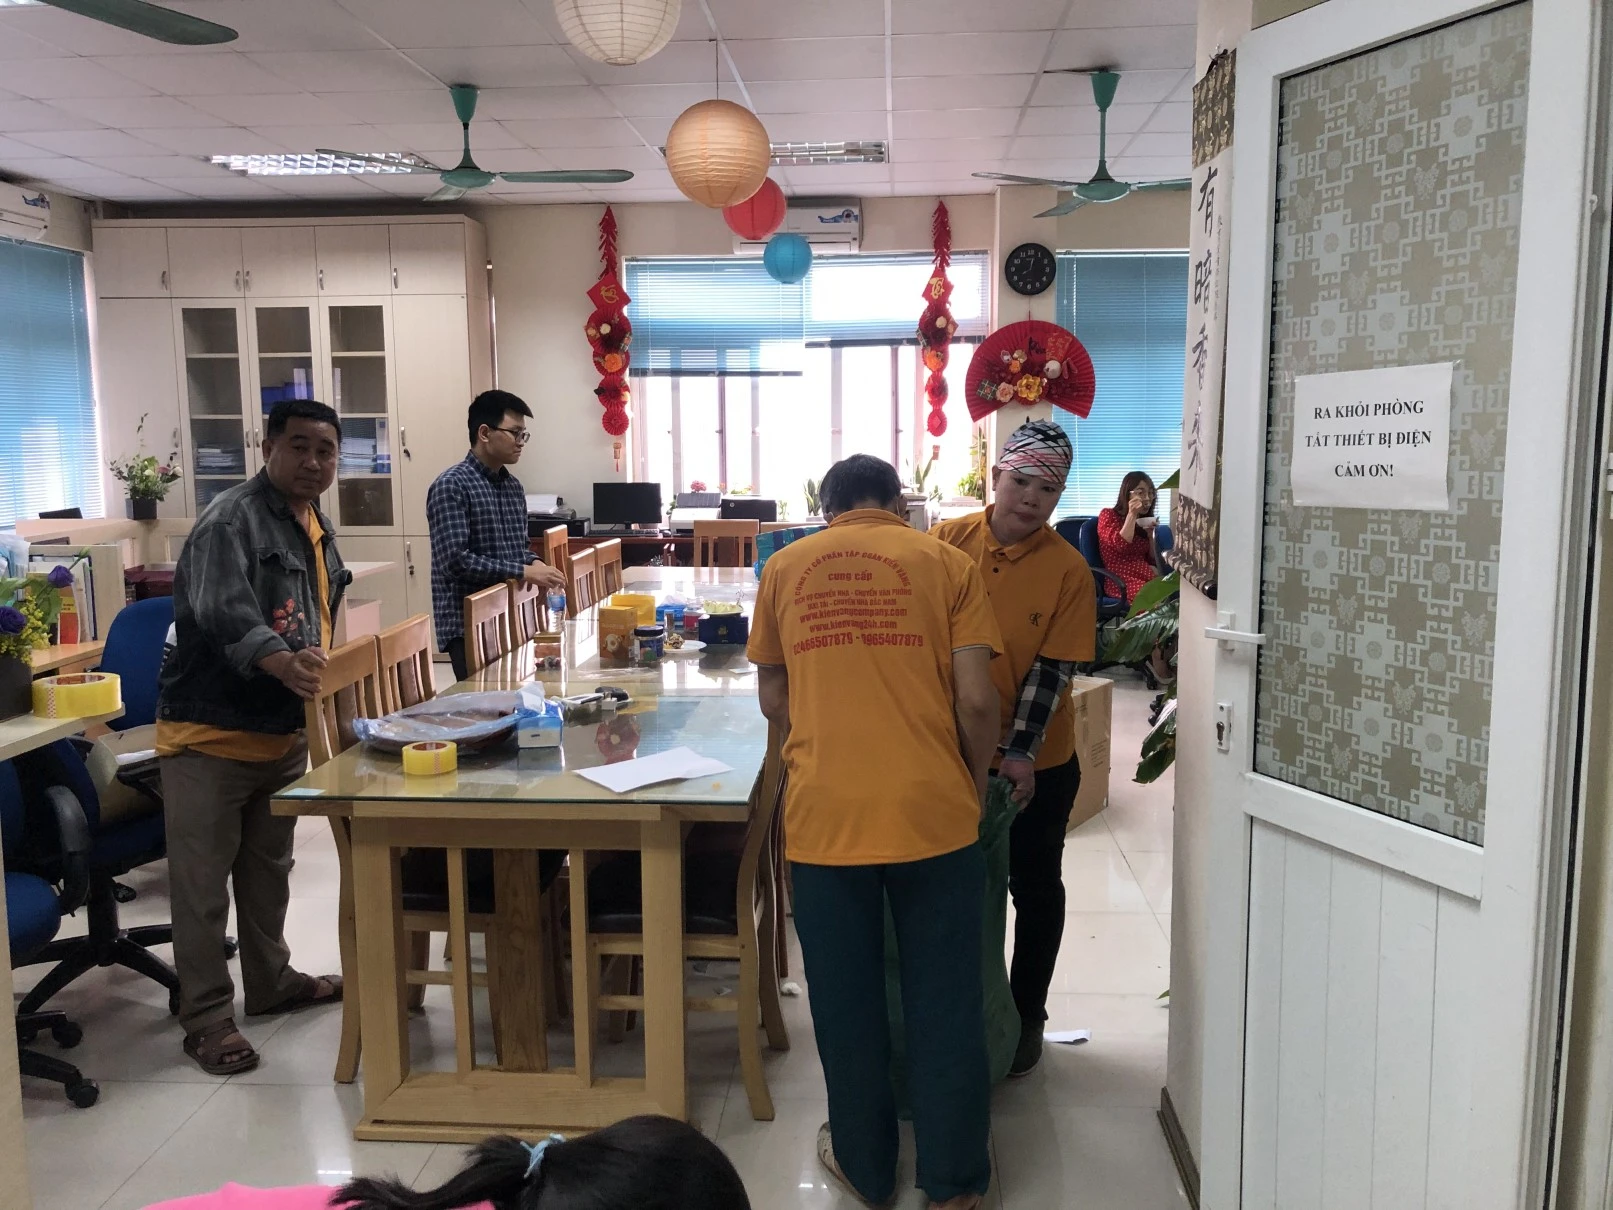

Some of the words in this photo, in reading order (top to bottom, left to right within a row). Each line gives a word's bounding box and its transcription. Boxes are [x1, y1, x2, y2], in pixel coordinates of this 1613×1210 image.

[1314, 407, 1332, 420] RA
[1335, 401, 1370, 418] KHỎI
[1373, 398, 1425, 416] PHÒNG
[1334, 429, 1375, 446] THIẾT
[1378, 432, 1392, 449] BỊ
[1396, 429, 1432, 448] ĐIỆN
[1334, 461, 1366, 478] CẢM
[1368, 463, 1394, 478] ƠN!
[804, 566, 812, 576] TY
[828, 573, 851, 581] cung
[854, 569, 872, 581] cấp
